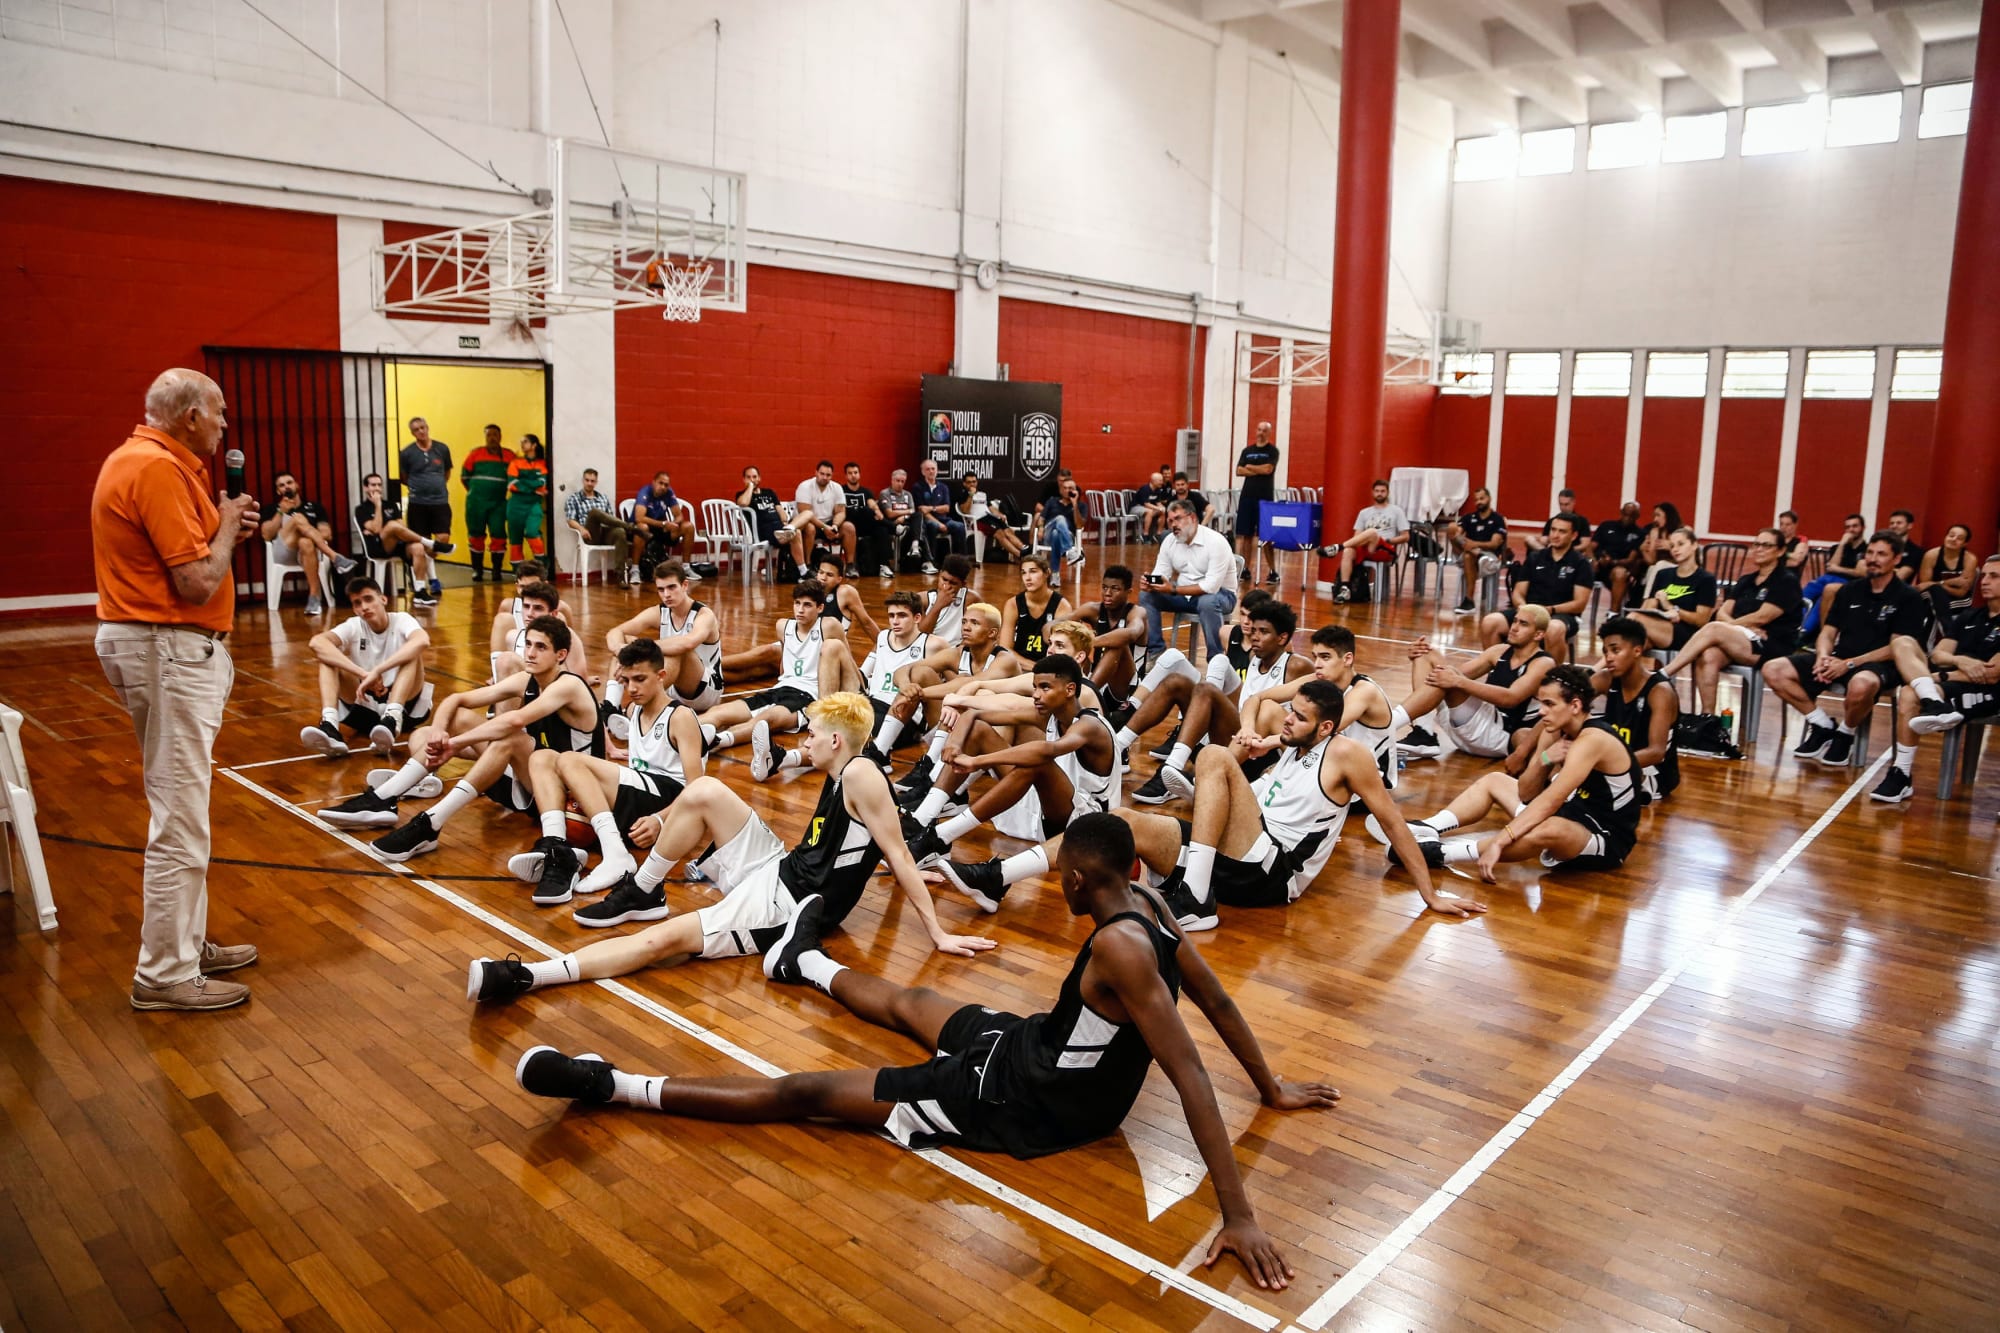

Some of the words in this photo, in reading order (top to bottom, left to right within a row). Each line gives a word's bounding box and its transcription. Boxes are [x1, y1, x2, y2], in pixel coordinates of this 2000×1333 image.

[953, 411, 980, 432] YOUTH
[932, 450, 948, 461] FIBA
[953, 435, 1008, 456] DEVELOPMENT
[1022, 436, 1054, 460] FIBA
[952, 460, 993, 479] PROGRAM
[1026, 634, 1042, 652] 24
[794, 658, 804, 677] 8
[1264, 781, 1282, 807] 5
